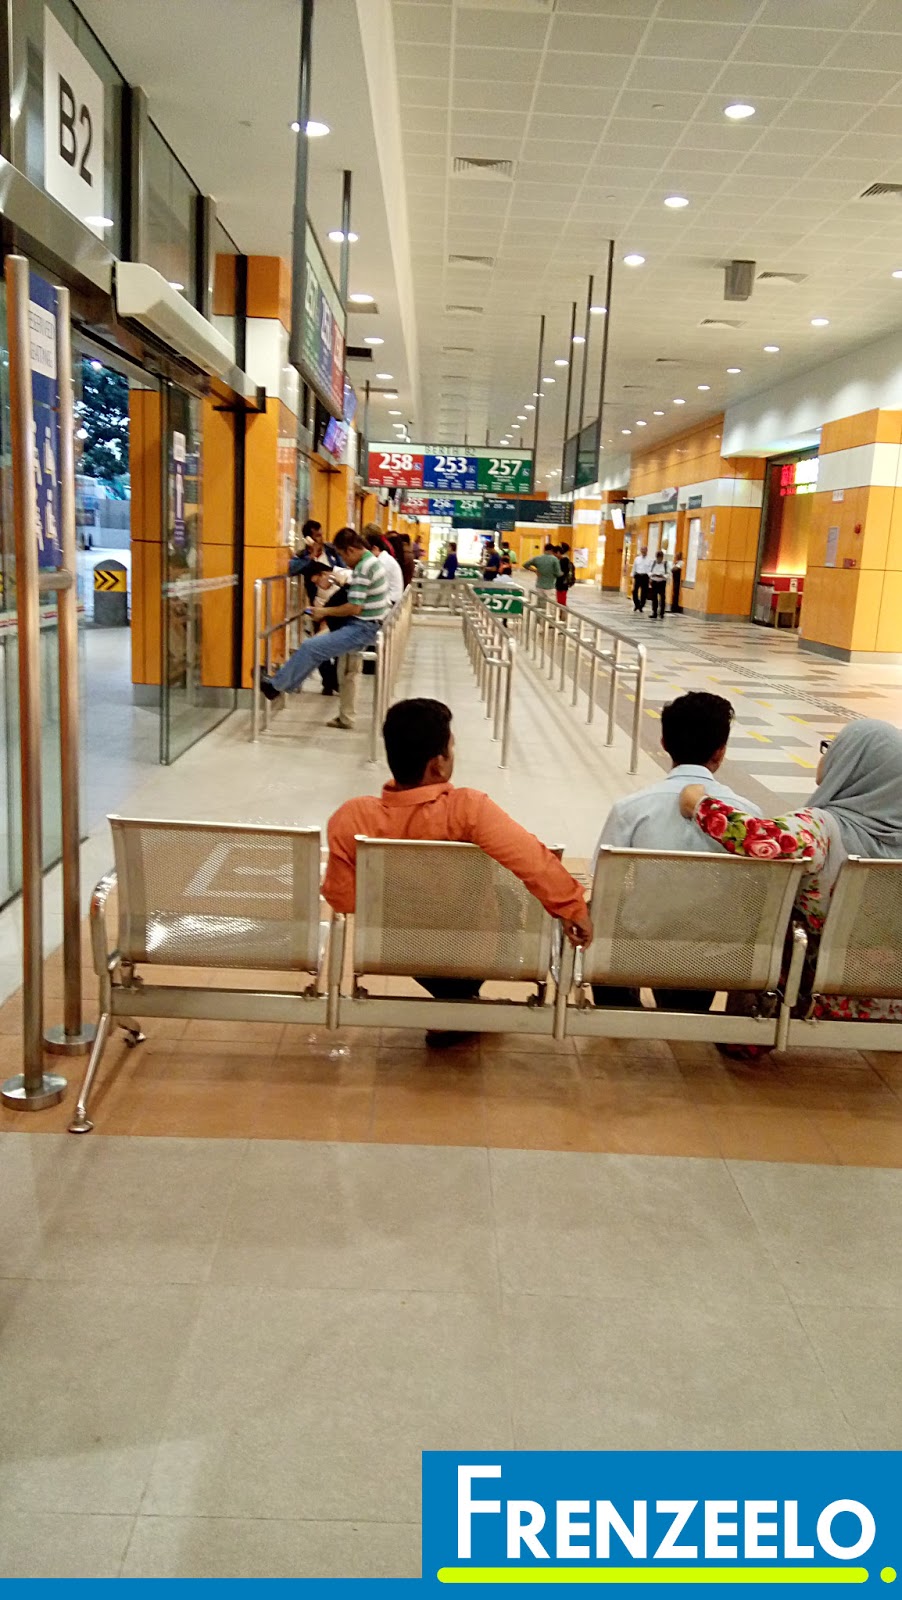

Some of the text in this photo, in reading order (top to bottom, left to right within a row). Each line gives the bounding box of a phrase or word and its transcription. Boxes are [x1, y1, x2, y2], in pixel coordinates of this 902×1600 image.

[58, 72, 93, 187] B2
[28, 309, 55, 340] ESERVED
[30, 341, 54, 369] EATING
[378, 453, 523, 476] 258 253 257
[480, 593, 515, 610] 257
